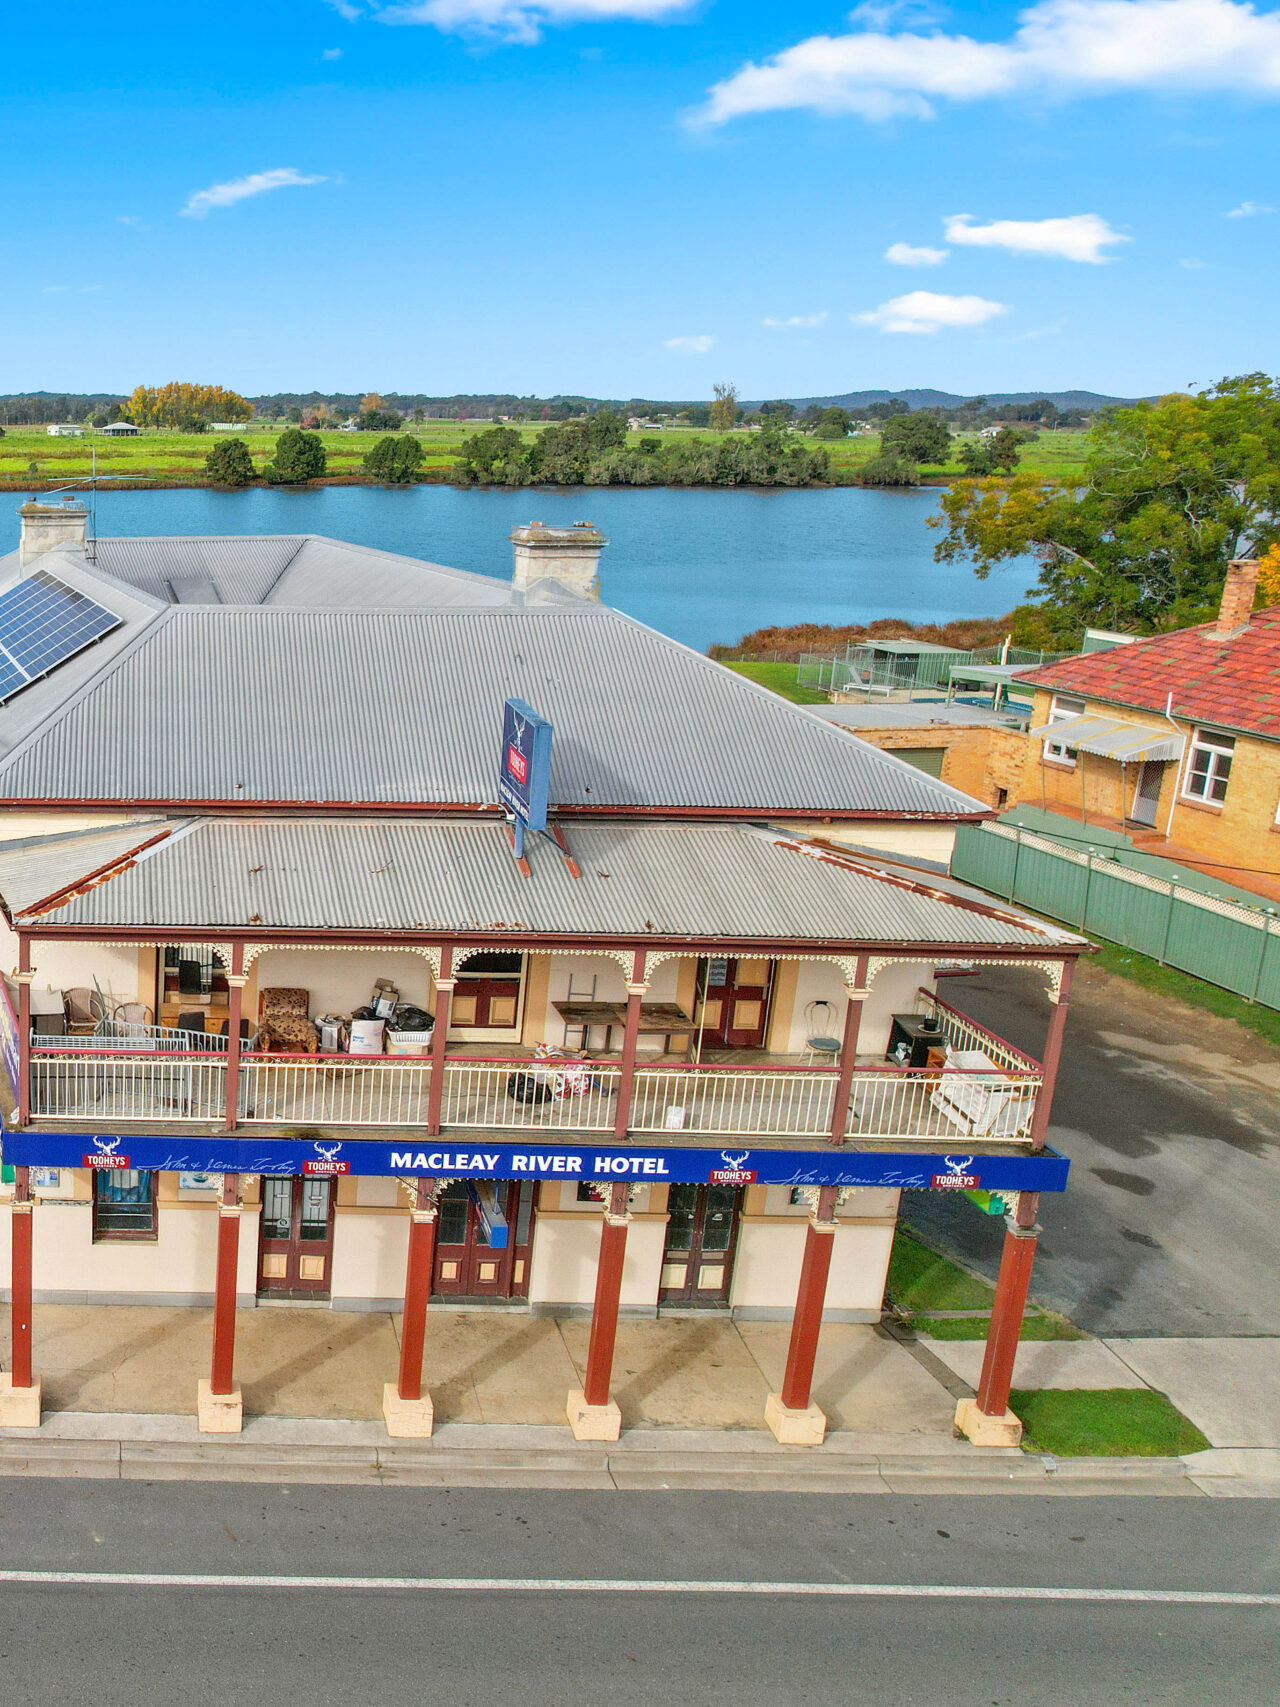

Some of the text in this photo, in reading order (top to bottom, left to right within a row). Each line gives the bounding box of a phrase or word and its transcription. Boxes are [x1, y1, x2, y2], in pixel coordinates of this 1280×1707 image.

[87, 1155, 126, 1166] TOOHEYS
[390, 1152, 669, 1175] MACLEAY RIVER HOTEL
[307, 1161, 346, 1172] TOOHEYS
[713, 1170, 752, 1180] TOOHEYS
[935, 1175, 975, 1186] TOOHEYS
